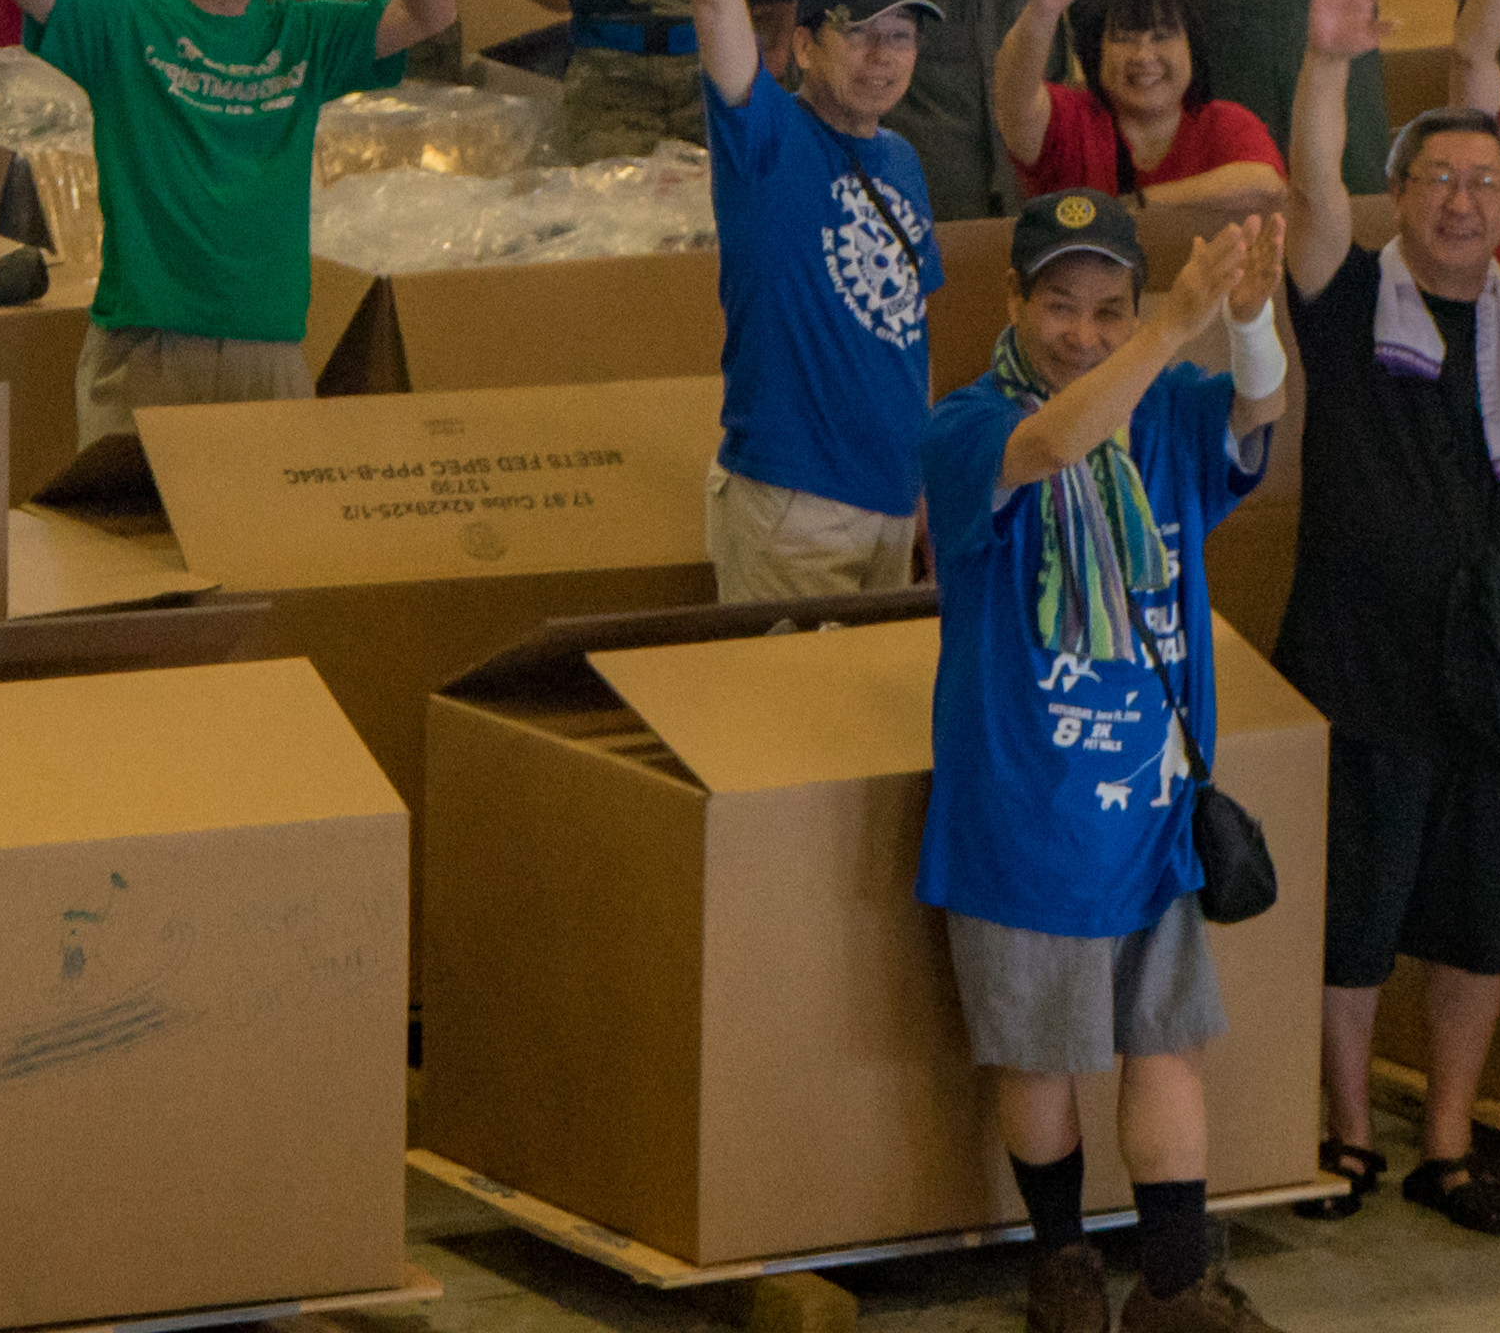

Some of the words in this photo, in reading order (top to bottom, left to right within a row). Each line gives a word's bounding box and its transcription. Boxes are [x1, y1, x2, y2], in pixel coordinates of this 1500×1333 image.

[430, 456, 492, 477] SPEC
[496, 453, 543, 472] FED
[546, 449, 624, 469] MEETS
[283, 462, 425, 485] PPP-B-1364C
[1053, 717, 1082, 748] &
